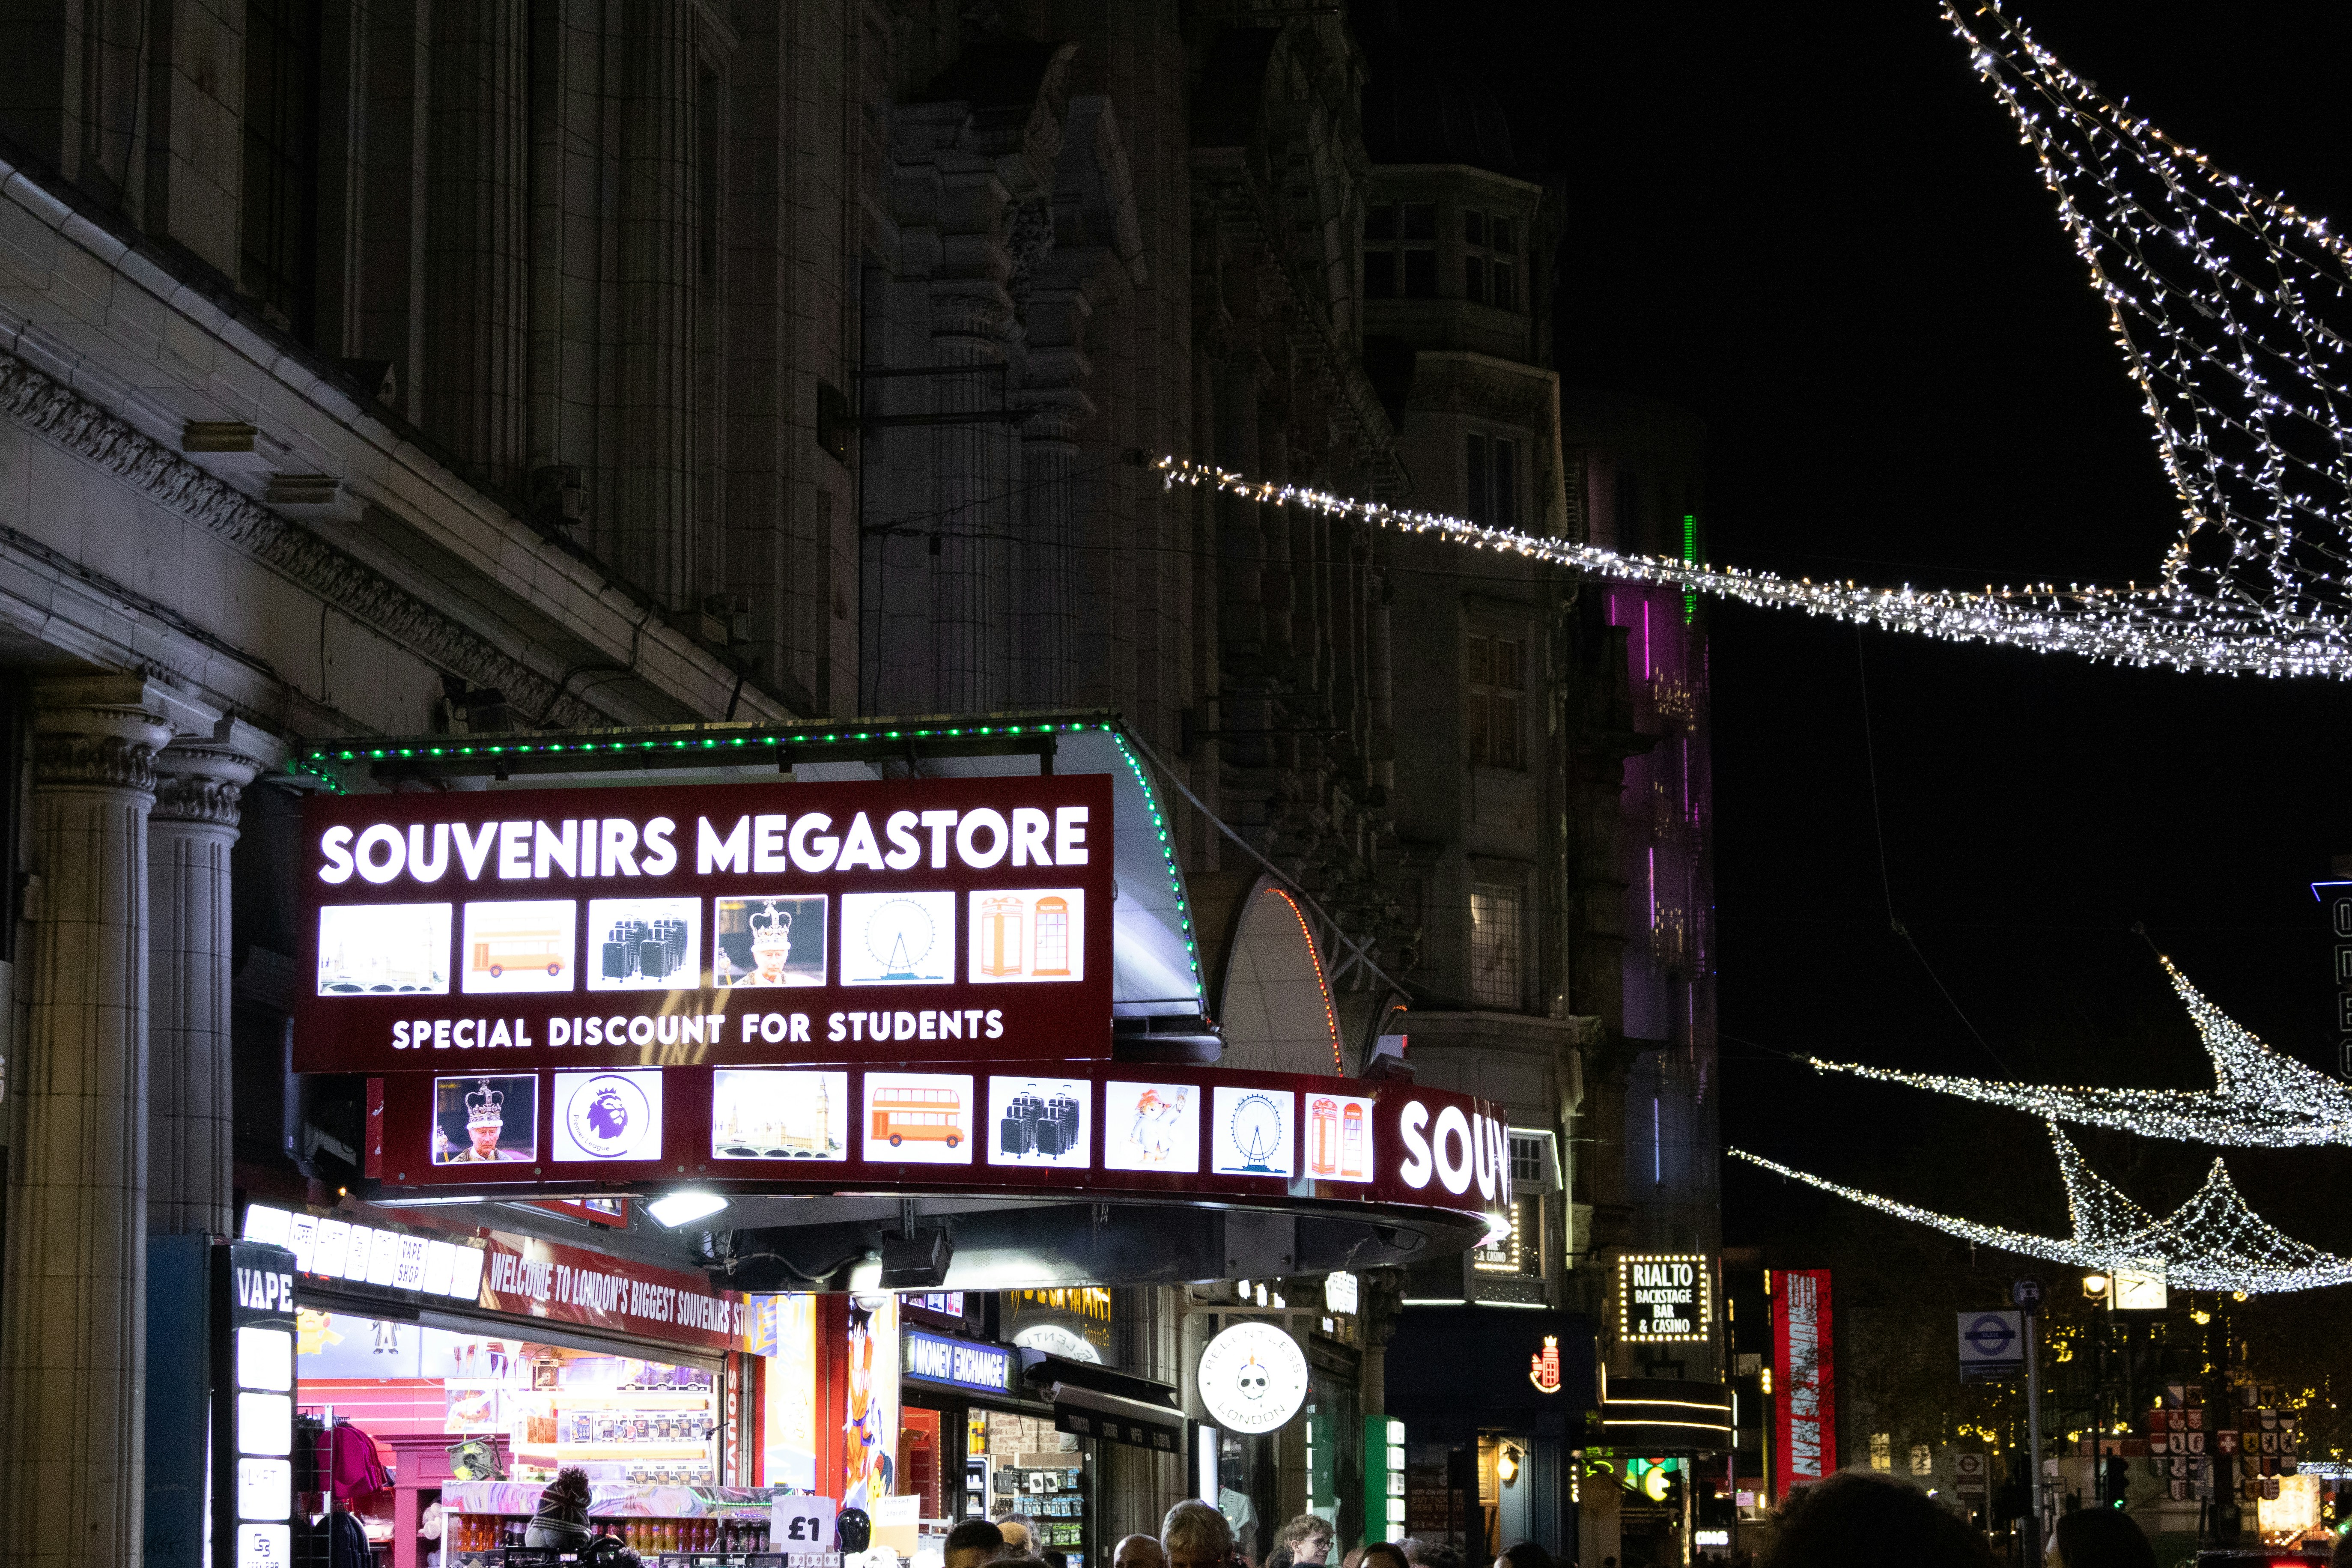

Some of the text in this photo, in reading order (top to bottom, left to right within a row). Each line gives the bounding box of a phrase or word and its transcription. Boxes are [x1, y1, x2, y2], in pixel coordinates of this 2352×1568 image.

[319, 806, 1089, 884] SOUVENIRS MEGASTORE
[392, 1009, 1003, 1049] SPECIAL DISCOUNT FOR STUDENTS
[572, 1114, 585, 1142] Premier
[584, 1136, 610, 1151] League
[402, 1240, 423, 1262] VAPE
[1487, 1251, 1506, 1262] CASINO
[397, 1263, 419, 1284] SHOP
[1633, 1264, 1693, 1287] RIALTO
[237, 1267, 293, 1313] VAPE
[491, 1252, 553, 1300] WELCOME
[555, 1264, 571, 1303] TO
[631, 1281, 676, 1323] BIGGEST
[677, 1291, 730, 1334] SOUVENIRS
[1635, 1289, 1692, 1304] BACKSTAGE
[1653, 1304, 1675, 1318] BAR
[1639, 1319, 1690, 1333] & CASINO
[916, 1338, 1003, 1388] MONEY EXCHANGE
[1205, 1330, 1302, 1374] RELENTLESS
[1217, 1401, 1285, 1425] LONDON
[727, 1369, 737, 1487] SOUVE
[788, 1517, 819, 1541] £1
